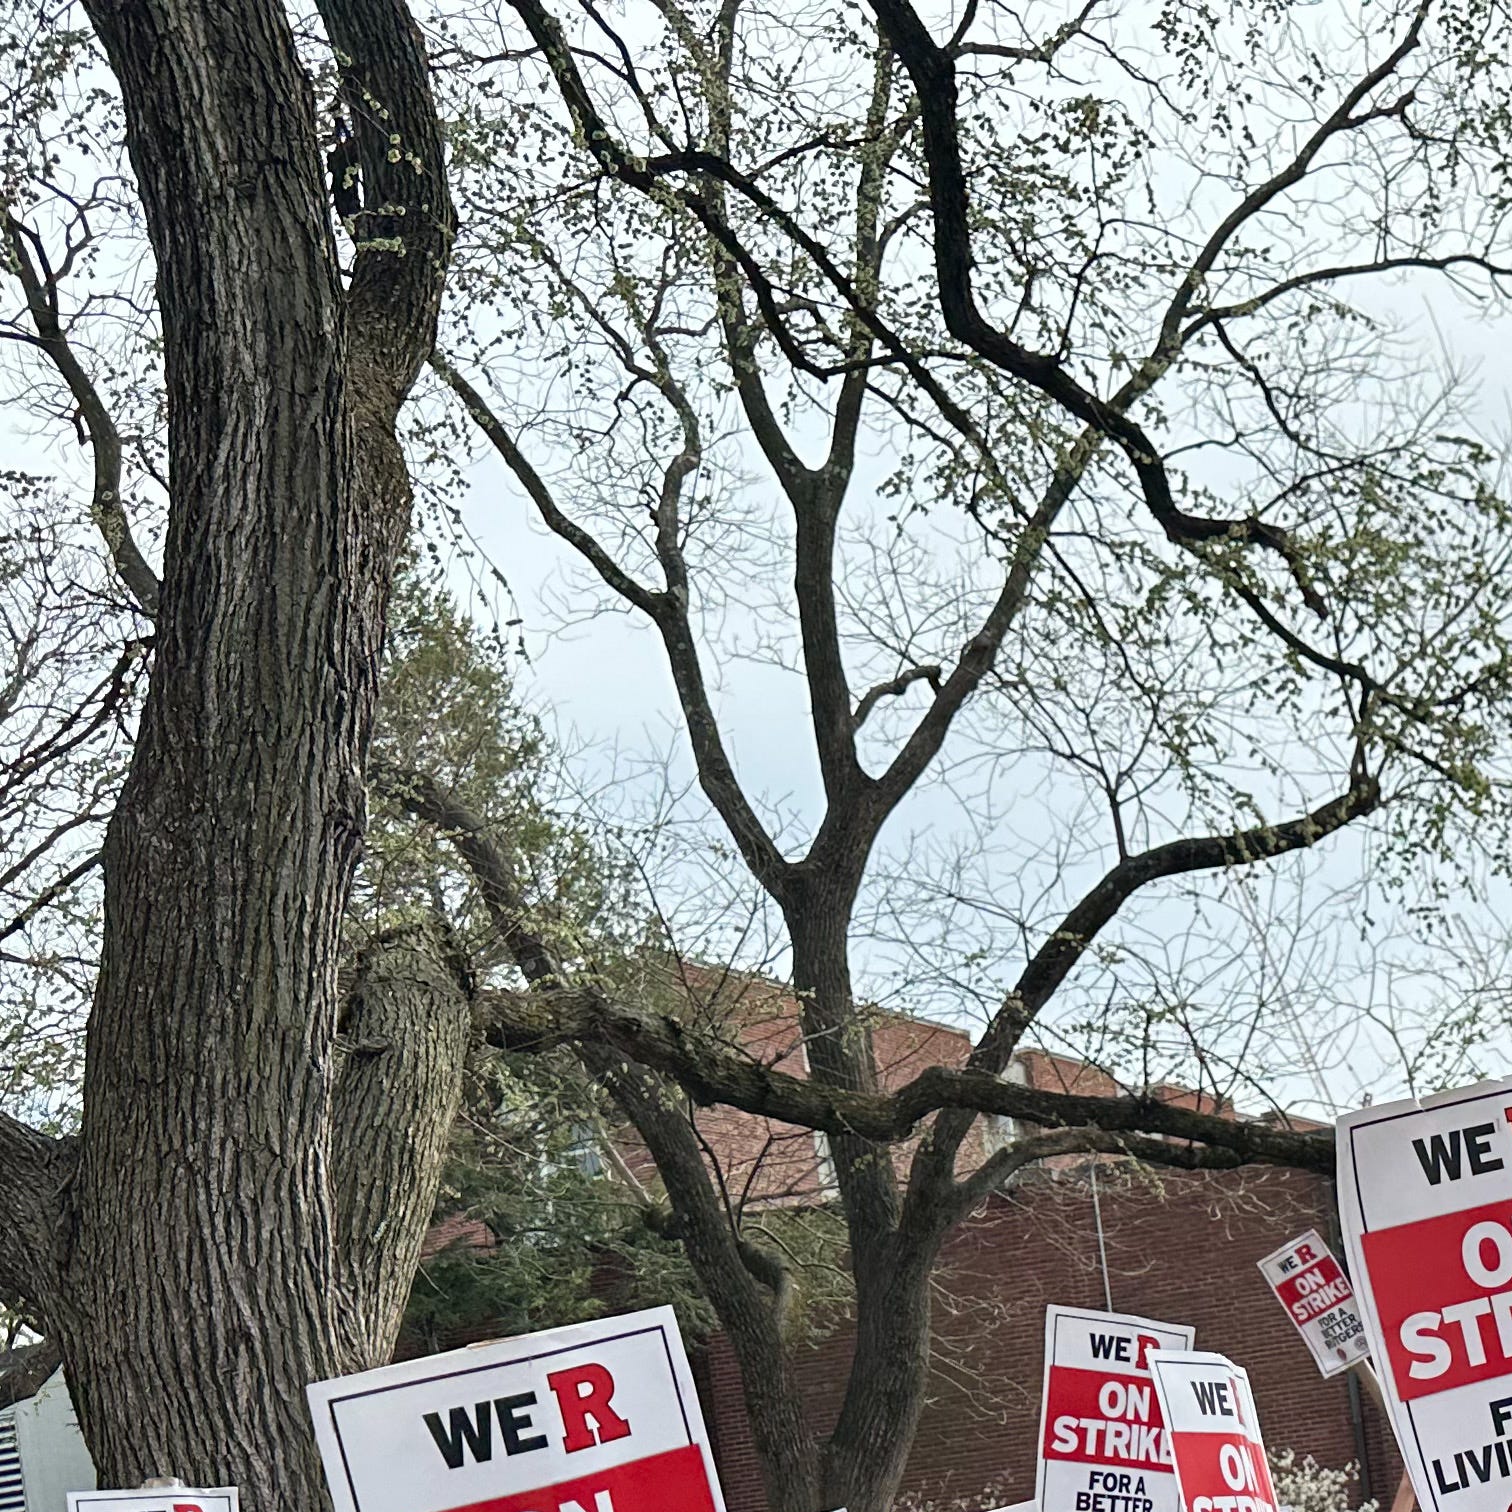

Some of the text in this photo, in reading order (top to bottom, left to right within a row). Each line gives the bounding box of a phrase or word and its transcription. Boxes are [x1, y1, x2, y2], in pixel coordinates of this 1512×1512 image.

[1412, 1122, 1504, 1186] WE
[1277, 1244, 1317, 1274] WE R
[1292, 1277, 1350, 1321] STRIKE
[1295, 1267, 1326, 1296] ON
[1089, 1333, 1131, 1362] WE
[421, 1362, 631, 1470] WE R
[1099, 1380, 1150, 1422] ON
[1190, 1381, 1233, 1416] WE
[1089, 1471, 1146, 1495] FOR A
